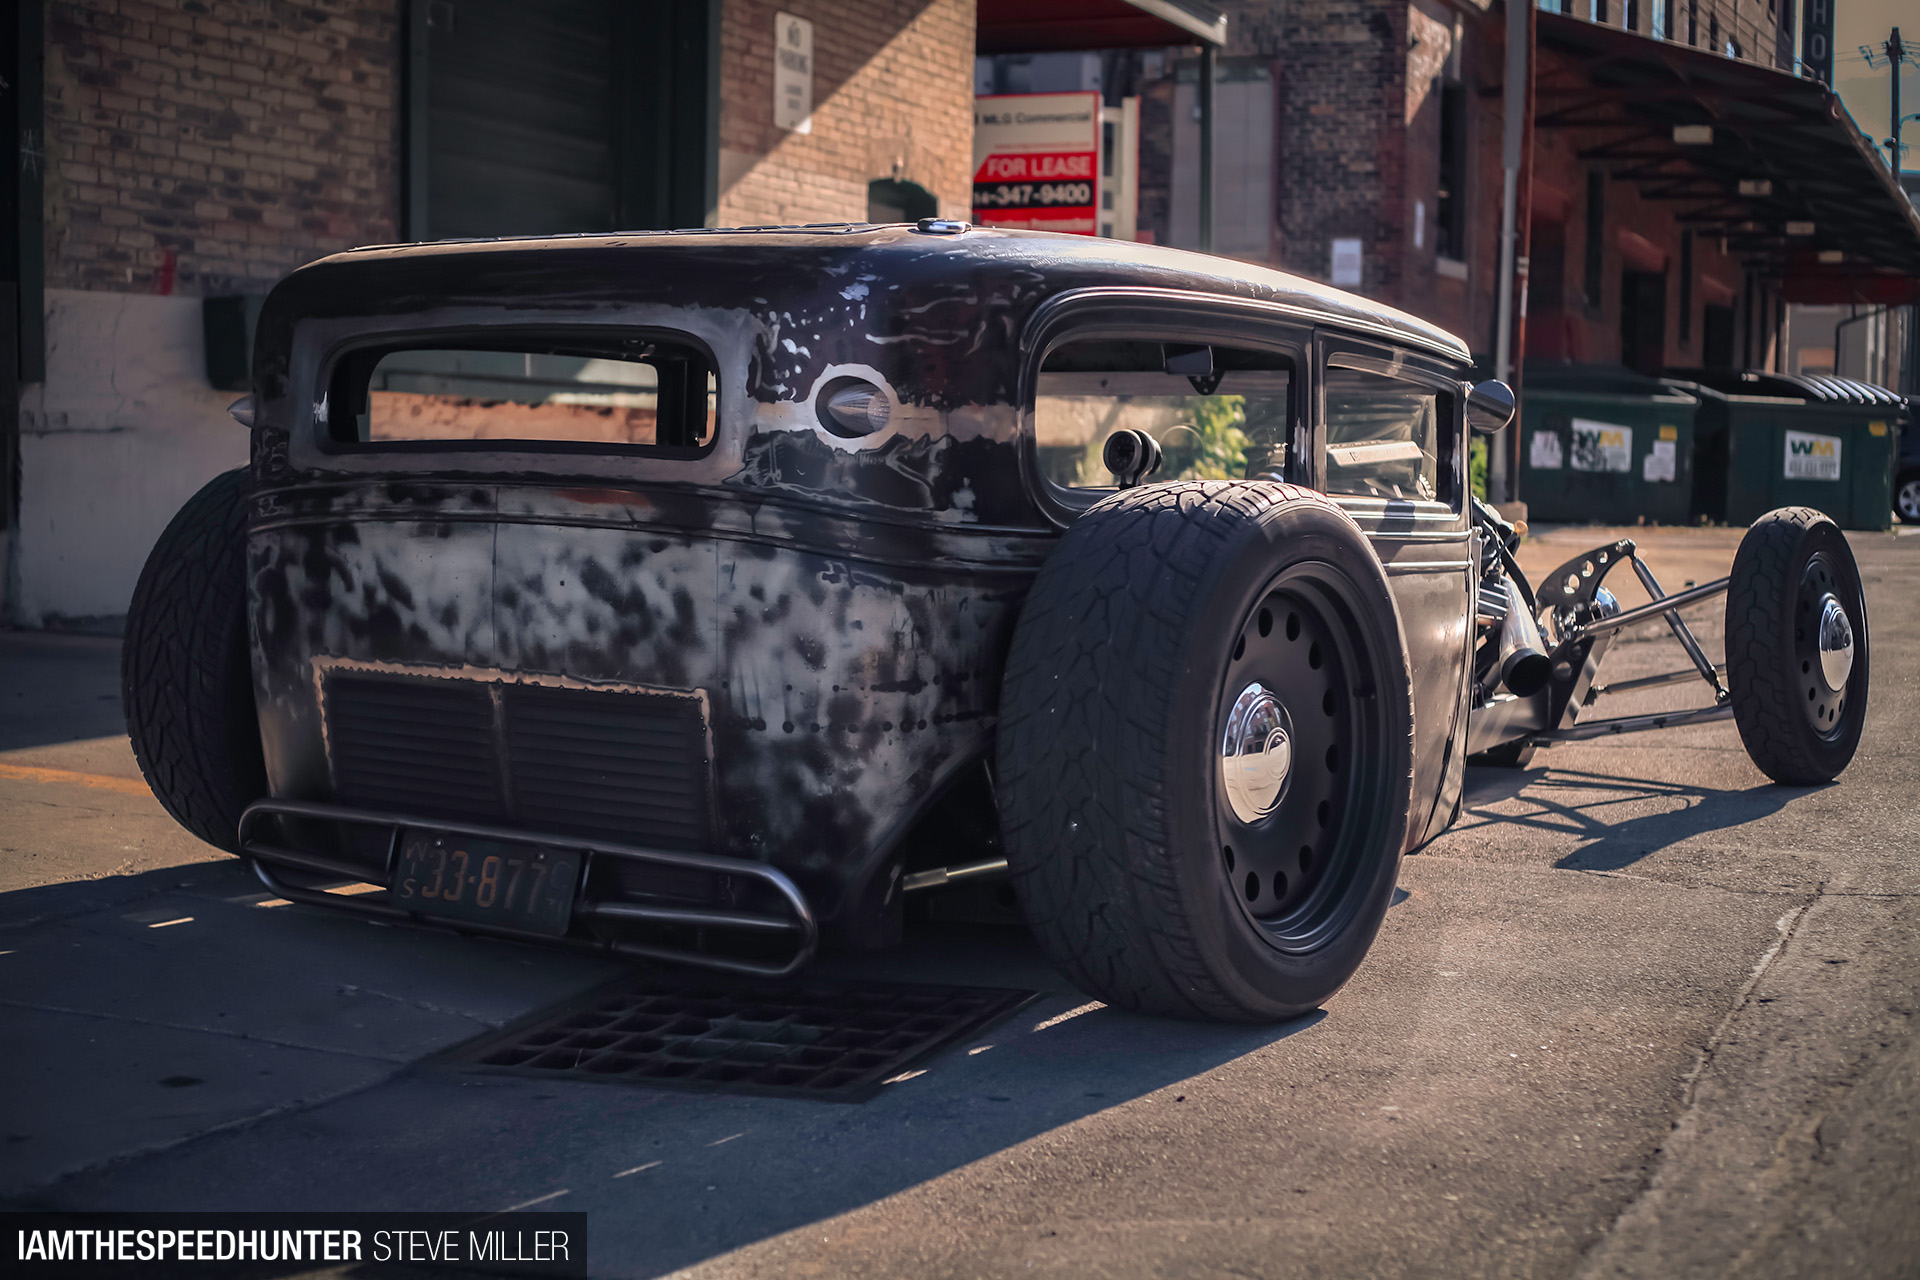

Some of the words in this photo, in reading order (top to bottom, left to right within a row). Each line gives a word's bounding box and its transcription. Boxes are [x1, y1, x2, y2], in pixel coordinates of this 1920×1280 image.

[987, 157, 1027, 178] FOR
[1030, 155, 1092, 177] LEASE
[1790, 440, 1835, 457] WM
